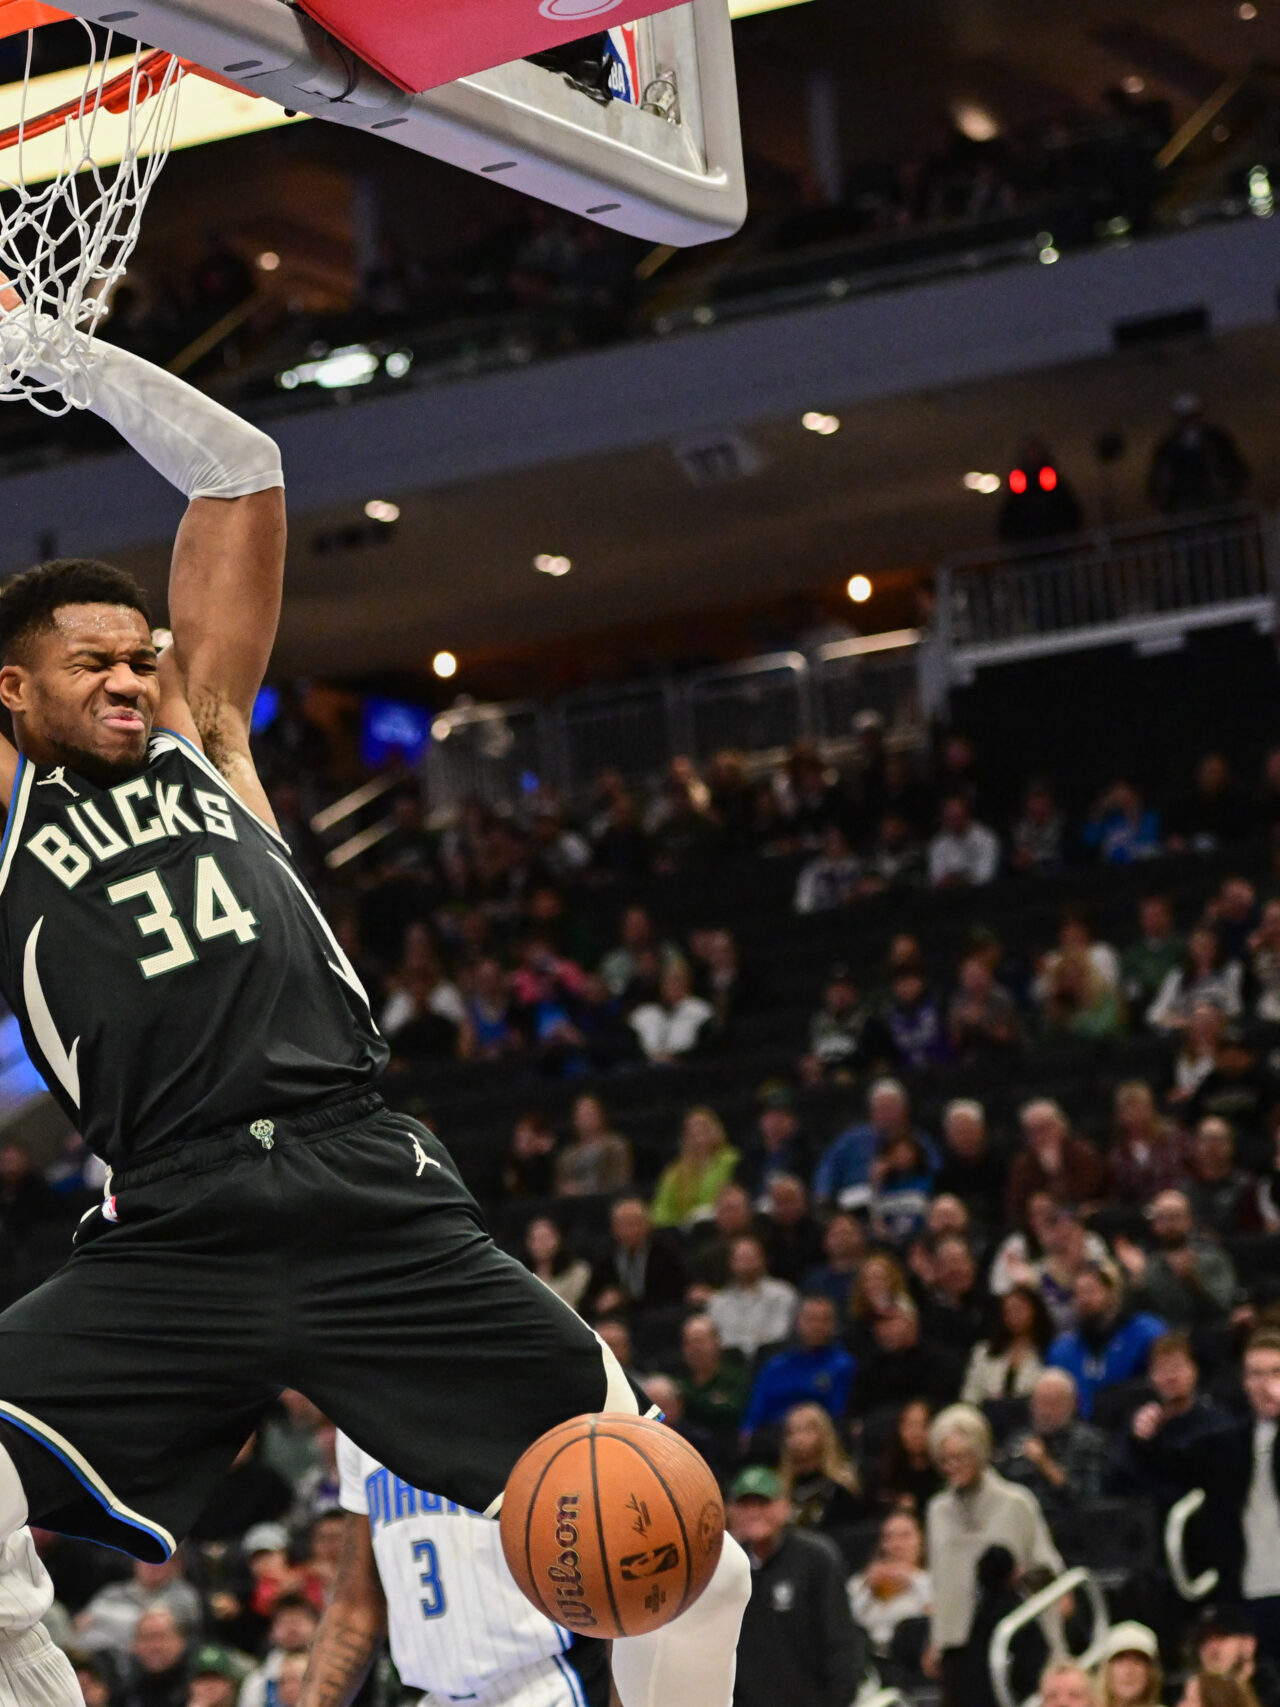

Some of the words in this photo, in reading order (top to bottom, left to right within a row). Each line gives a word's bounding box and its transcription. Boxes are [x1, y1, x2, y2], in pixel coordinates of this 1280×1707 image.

[25, 776, 239, 889] BUCKS
[106, 853, 260, 979] 34
[411, 1538, 449, 1620] 3
[547, 1494, 598, 1627] Wilson
